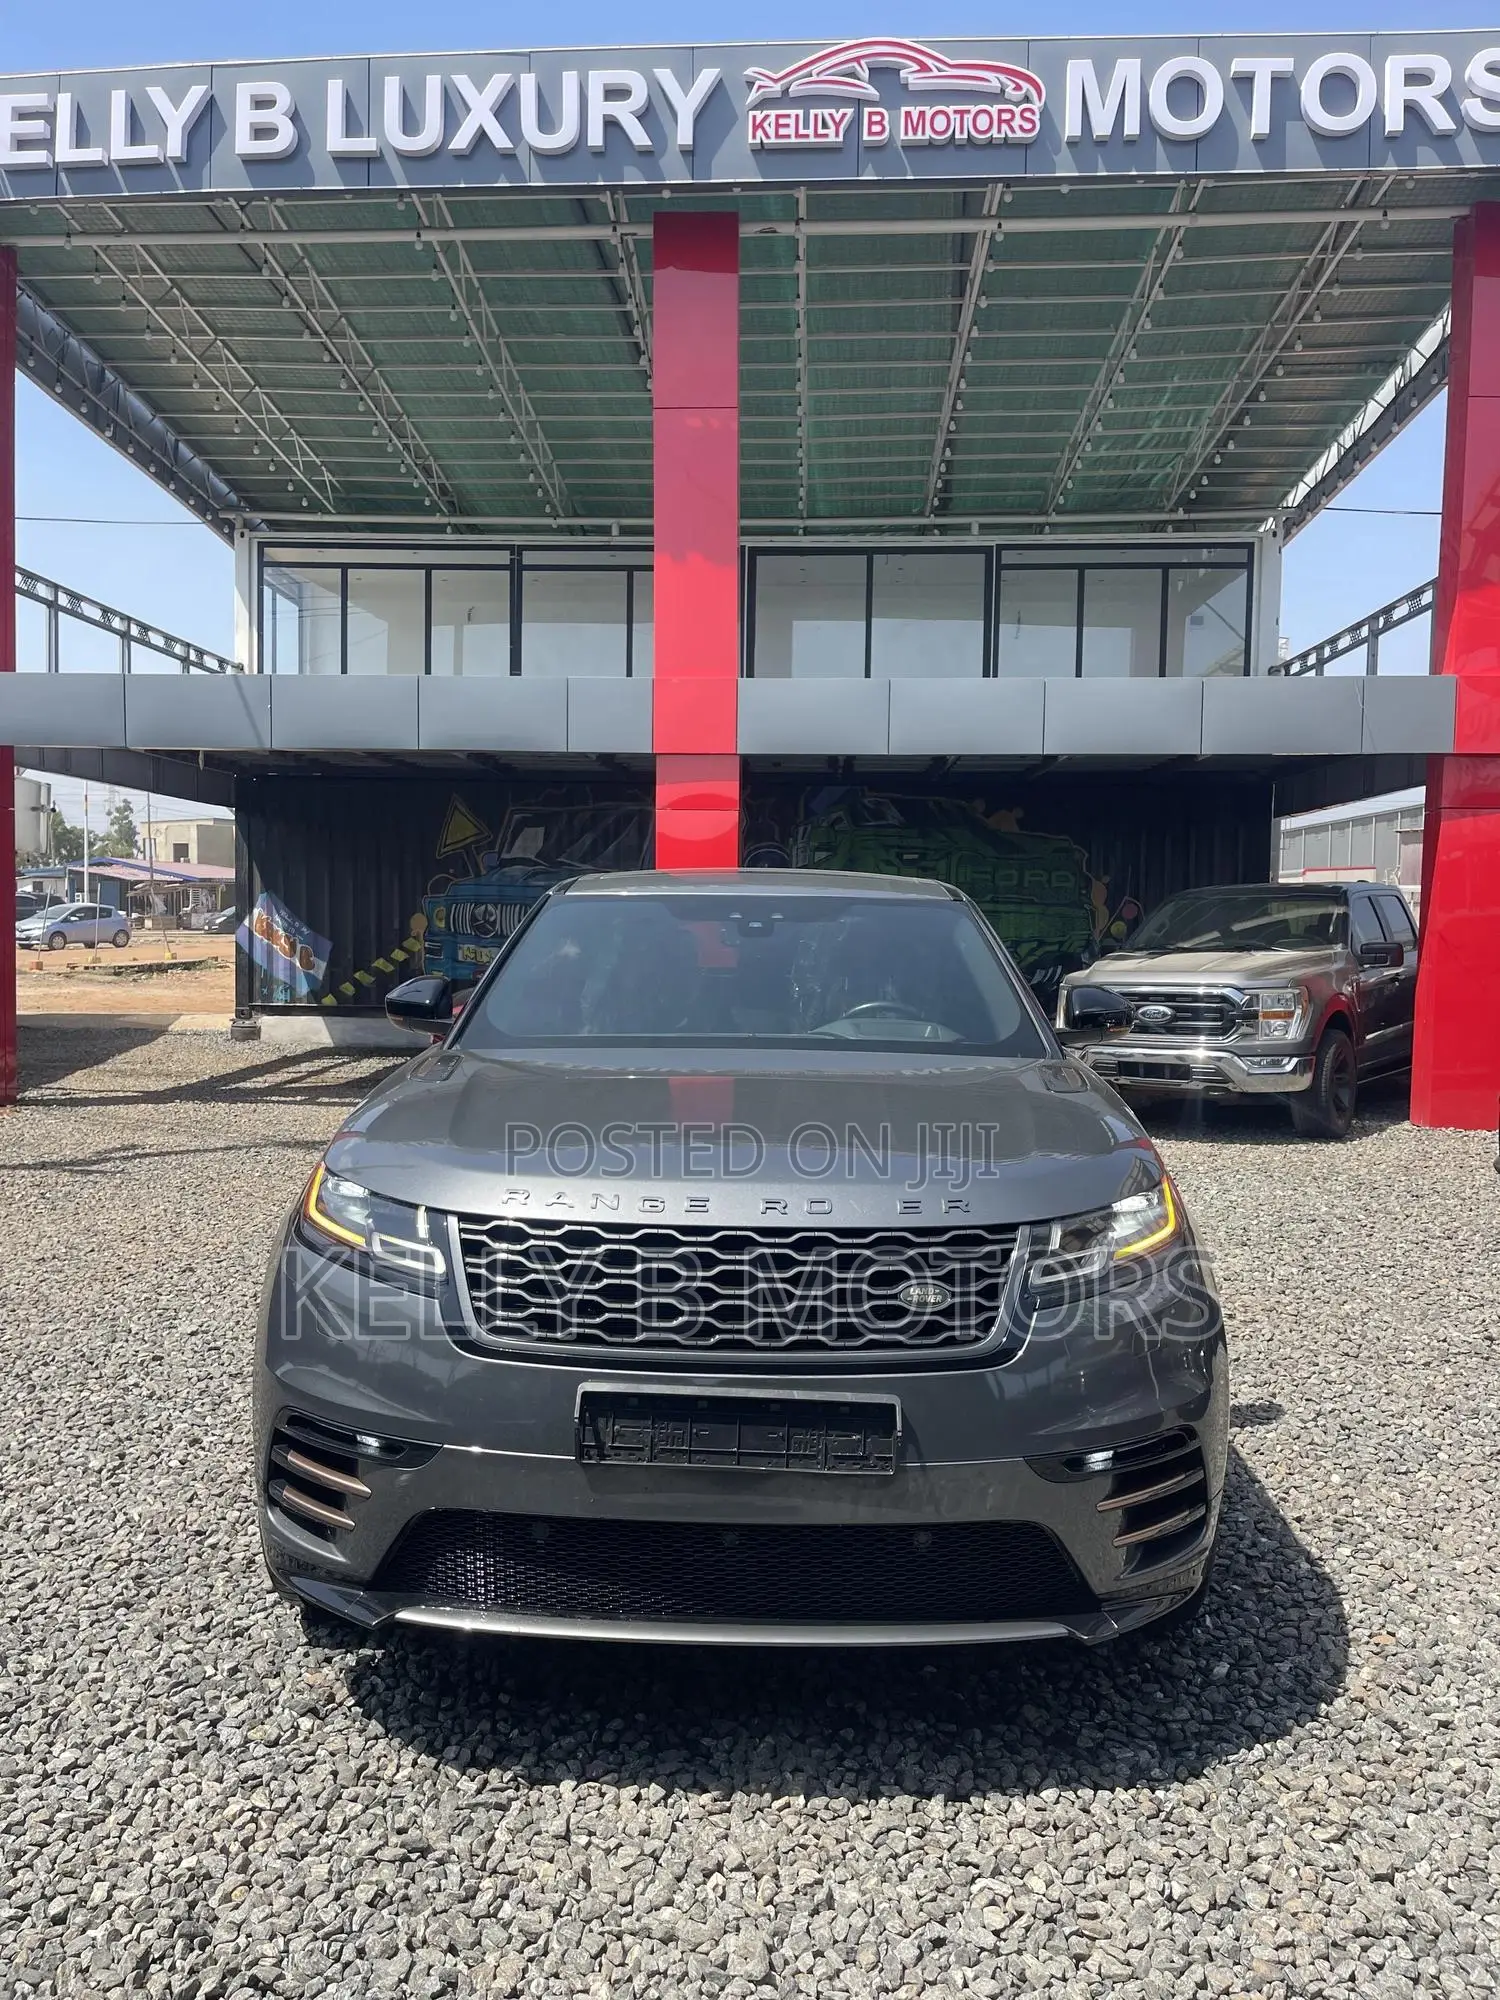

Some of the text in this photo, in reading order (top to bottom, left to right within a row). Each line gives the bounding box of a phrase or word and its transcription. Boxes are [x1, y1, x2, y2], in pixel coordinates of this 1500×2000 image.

[1064, 47, 1500, 142] MOTORS
[235, 81, 298, 160] B
[325, 68, 721, 159] LUXURY
[750, 105, 1040, 146] KELLY B MOTORS
[500, 1188, 713, 1215] RANGE
[909, 1287, 935, 1296] LAND
[911, 1294, 943, 1303] ROVER
